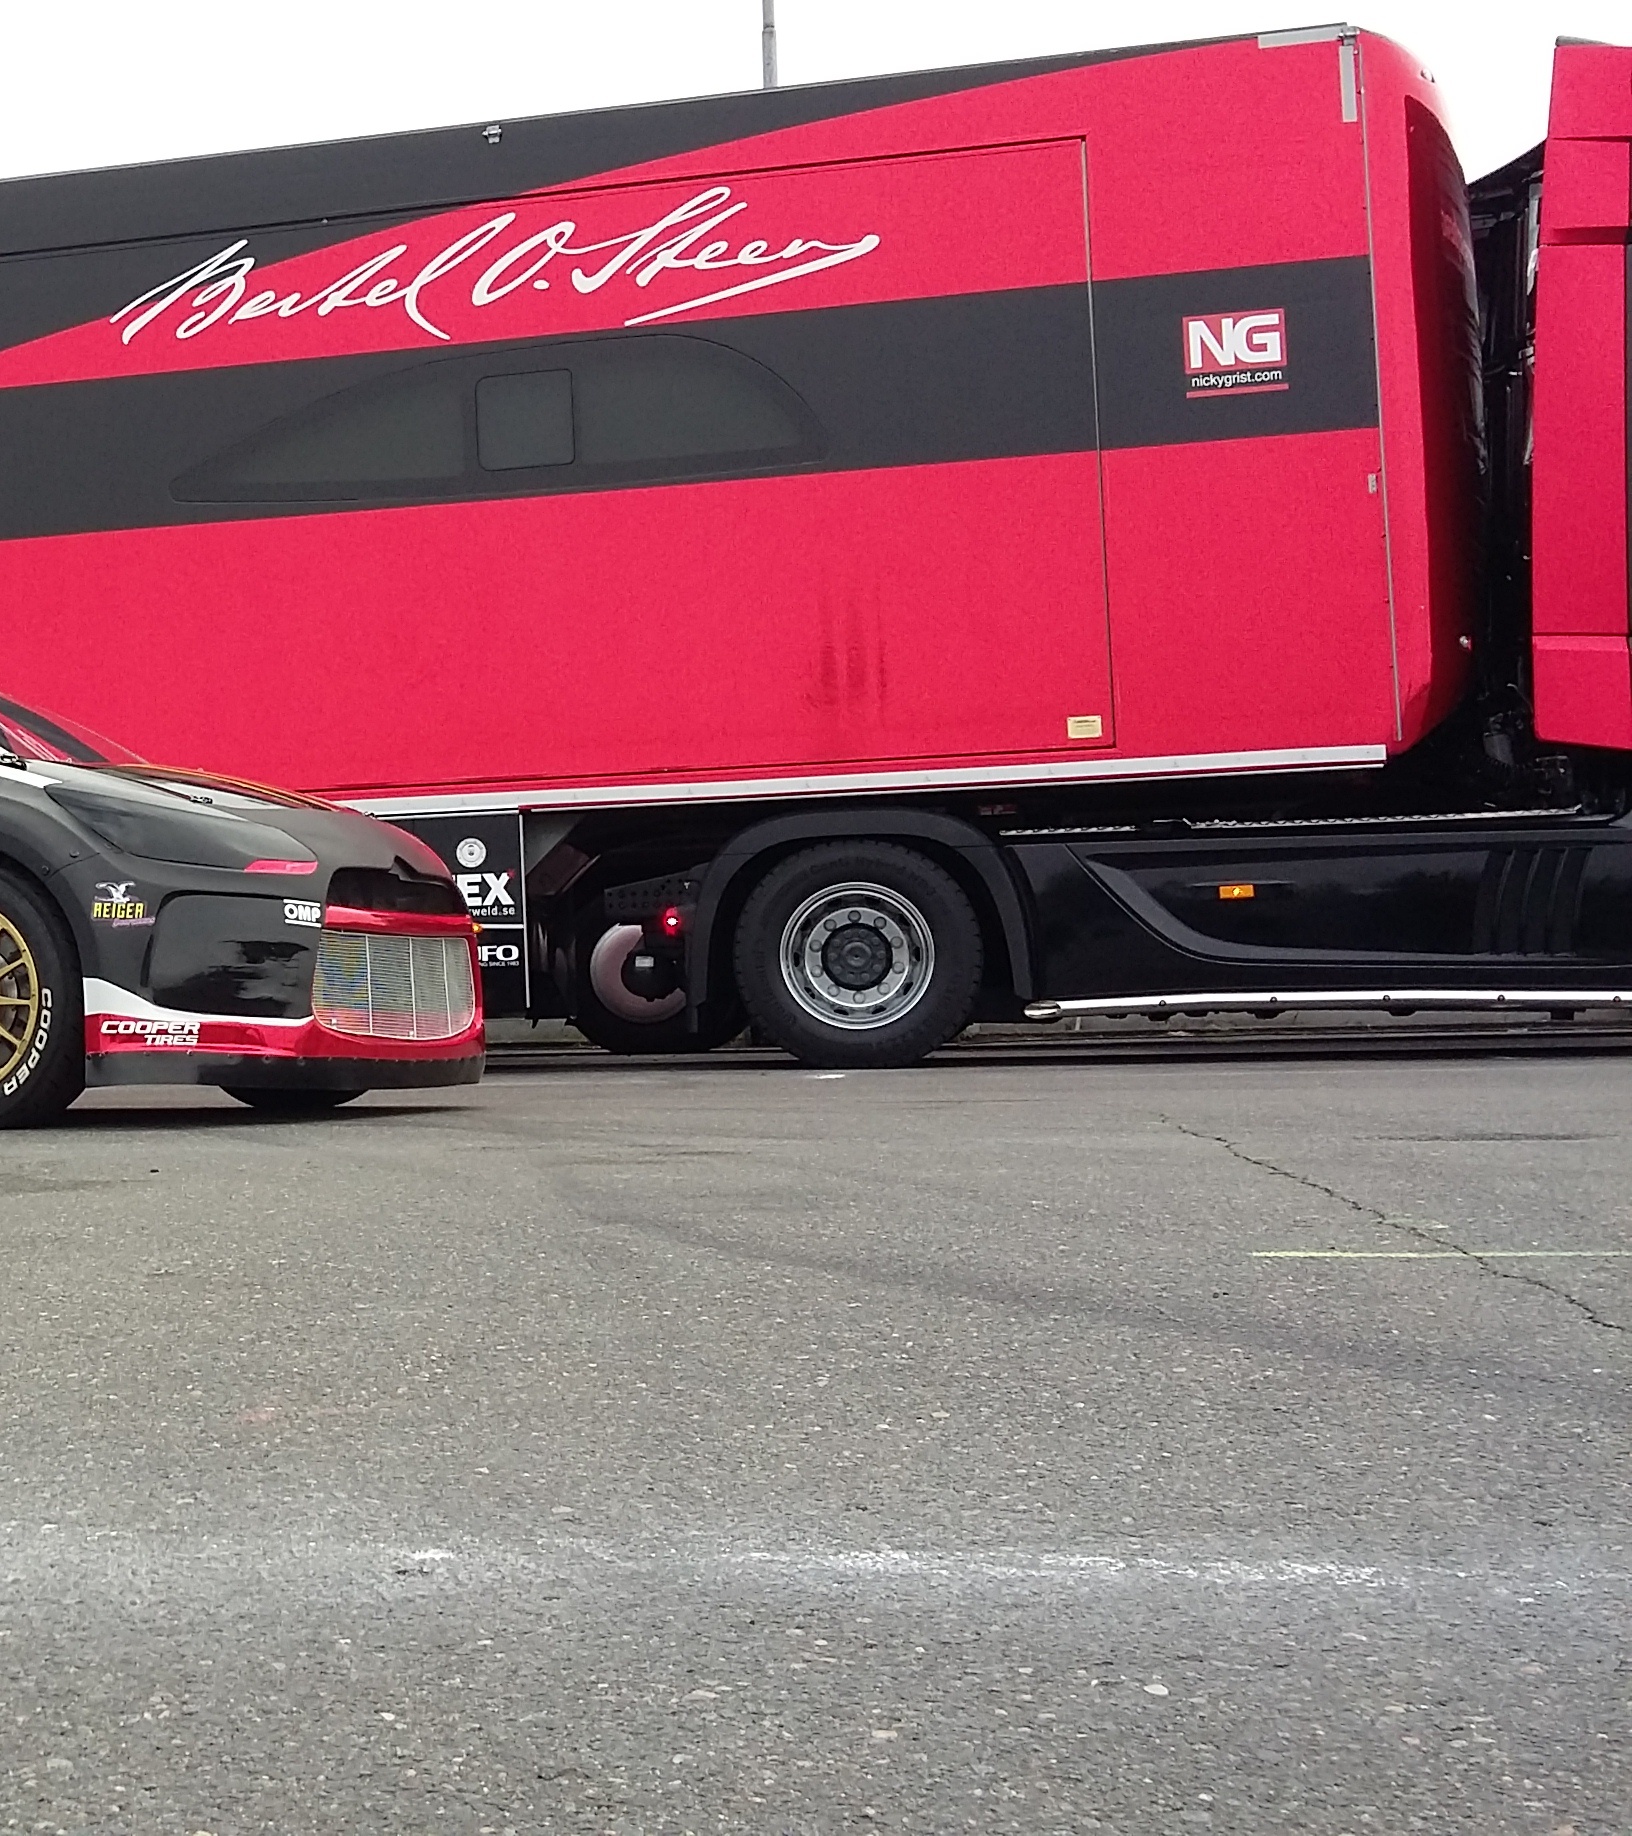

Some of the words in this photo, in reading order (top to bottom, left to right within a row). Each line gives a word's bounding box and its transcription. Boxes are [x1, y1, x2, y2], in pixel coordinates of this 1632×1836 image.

[1188, 313, 1282, 370] NG
[1191, 369, 1283, 389] nickygrist.com
[451, 872, 516, 907] EX
[93, 902, 144, 919] REIGER
[283, 903, 322, 923] OMP
[469, 905, 516, 917] weld.se
[476, 944, 520, 962] FO
[99, 1020, 202, 1035] COOPER
[2, 987, 53, 1096] COOPER
[144, 1034, 200, 1046] TIRES
